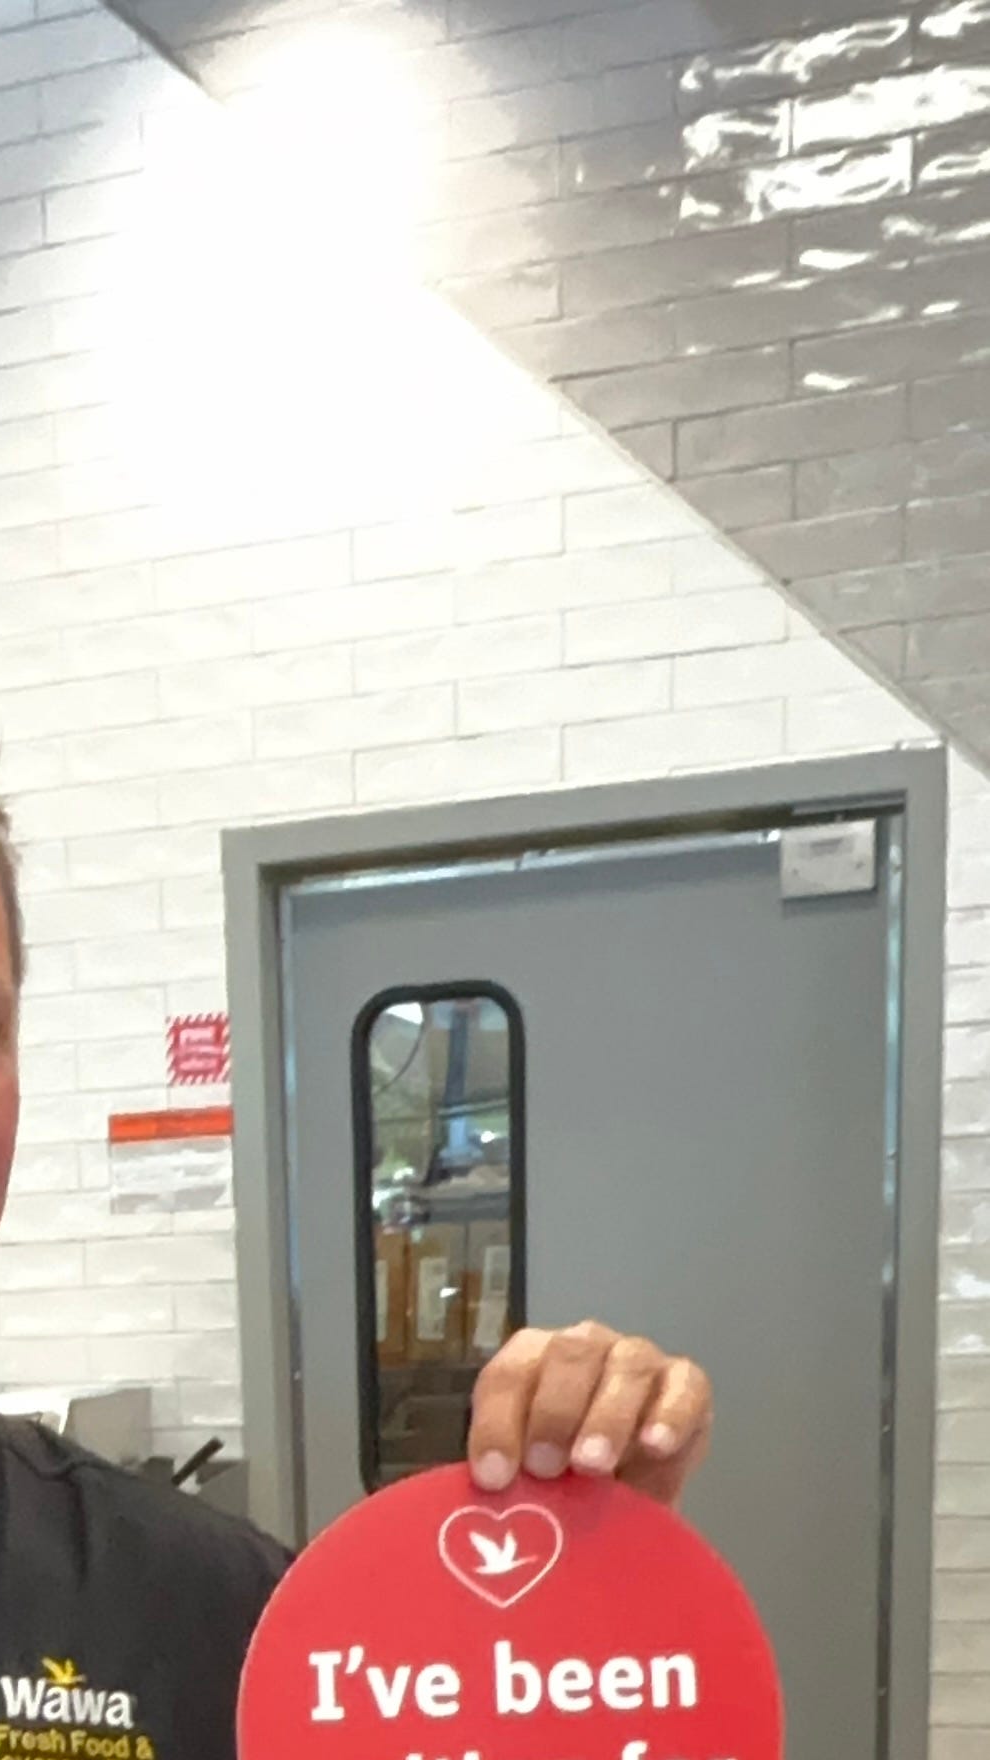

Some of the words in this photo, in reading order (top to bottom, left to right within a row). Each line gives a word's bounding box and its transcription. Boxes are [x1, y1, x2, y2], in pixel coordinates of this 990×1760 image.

[0, 1674, 134, 1729] Wawa
[309, 1646, 461, 1722] I've
[494, 1640, 698, 1716] been
[70, 1730, 130, 1760] Food
[135, 1734, 155, 1760] &
